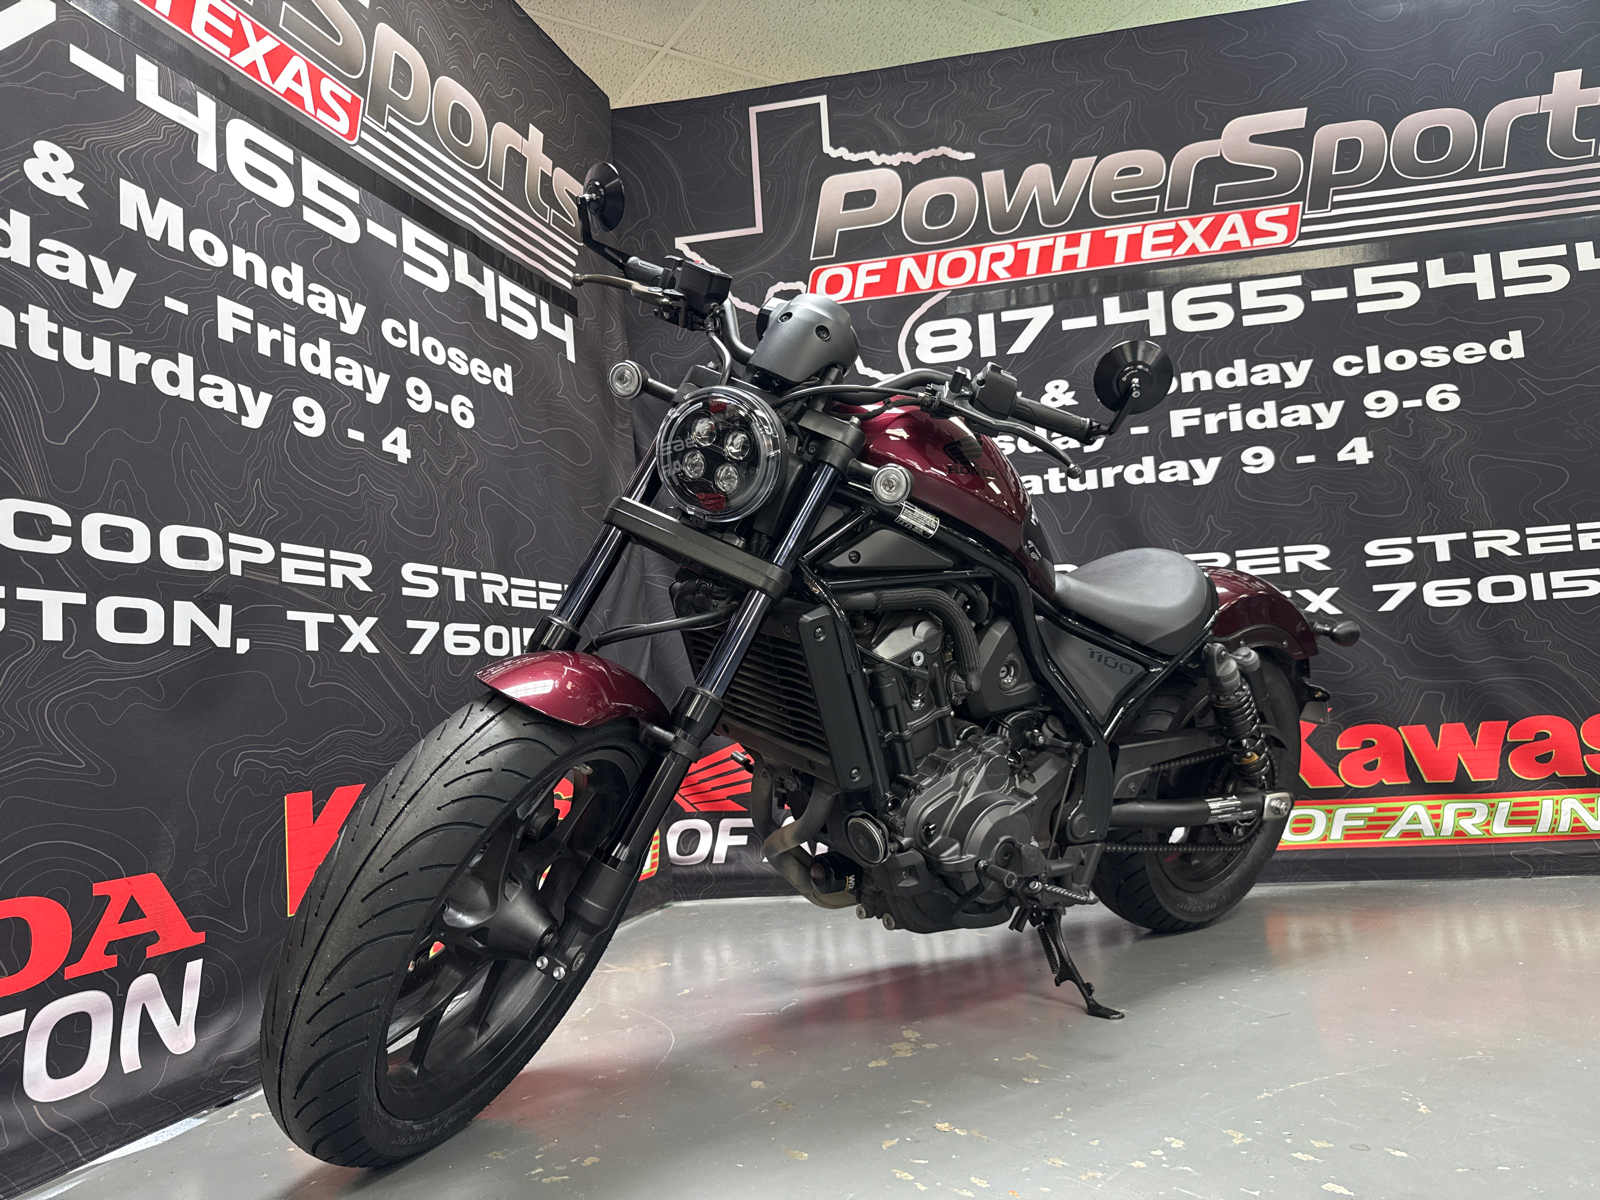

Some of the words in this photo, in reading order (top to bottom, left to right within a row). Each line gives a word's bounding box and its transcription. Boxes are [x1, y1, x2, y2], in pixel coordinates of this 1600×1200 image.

[149, 0, 353, 135] EXAS
[810, 69, 1600, 260] PowerSport
[23, 139, 89, 210] &
[119, 177, 367, 335] Monday
[380, 317, 514, 396] closed
[815, 261, 884, 301] OF
[898, 232, 1087, 292] NORTH
[1104, 205, 1291, 264] TEXAS
[216, 295, 391, 404] Friday
[404, 377, 476, 429] 9-6
[1039, 378, 1080, 408] &
[1331, 329, 1526, 377] closed
[291, 395, 327, 438] 9
[381, 426, 412, 464] 4
[1168, 399, 1345, 438] Friday
[1363, 382, 1462, 420] 9-6
[946, 464, 998, 479] HONDA
[1241, 445, 1276, 475] 9
[1335, 435, 1375, 467] 4
[0, 497, 374, 593] COOPER
[400, 562, 569, 612] STREE
[0, 585, 250, 654] TON,
[286, 609, 381, 654] TX
[1283, 586, 1344, 616] X
[1372, 567, 1600, 613] 76015
[1088, 647, 1134, 676] 1100
[665, 817, 755, 866] OF
[1281, 805, 1376, 843] OF
